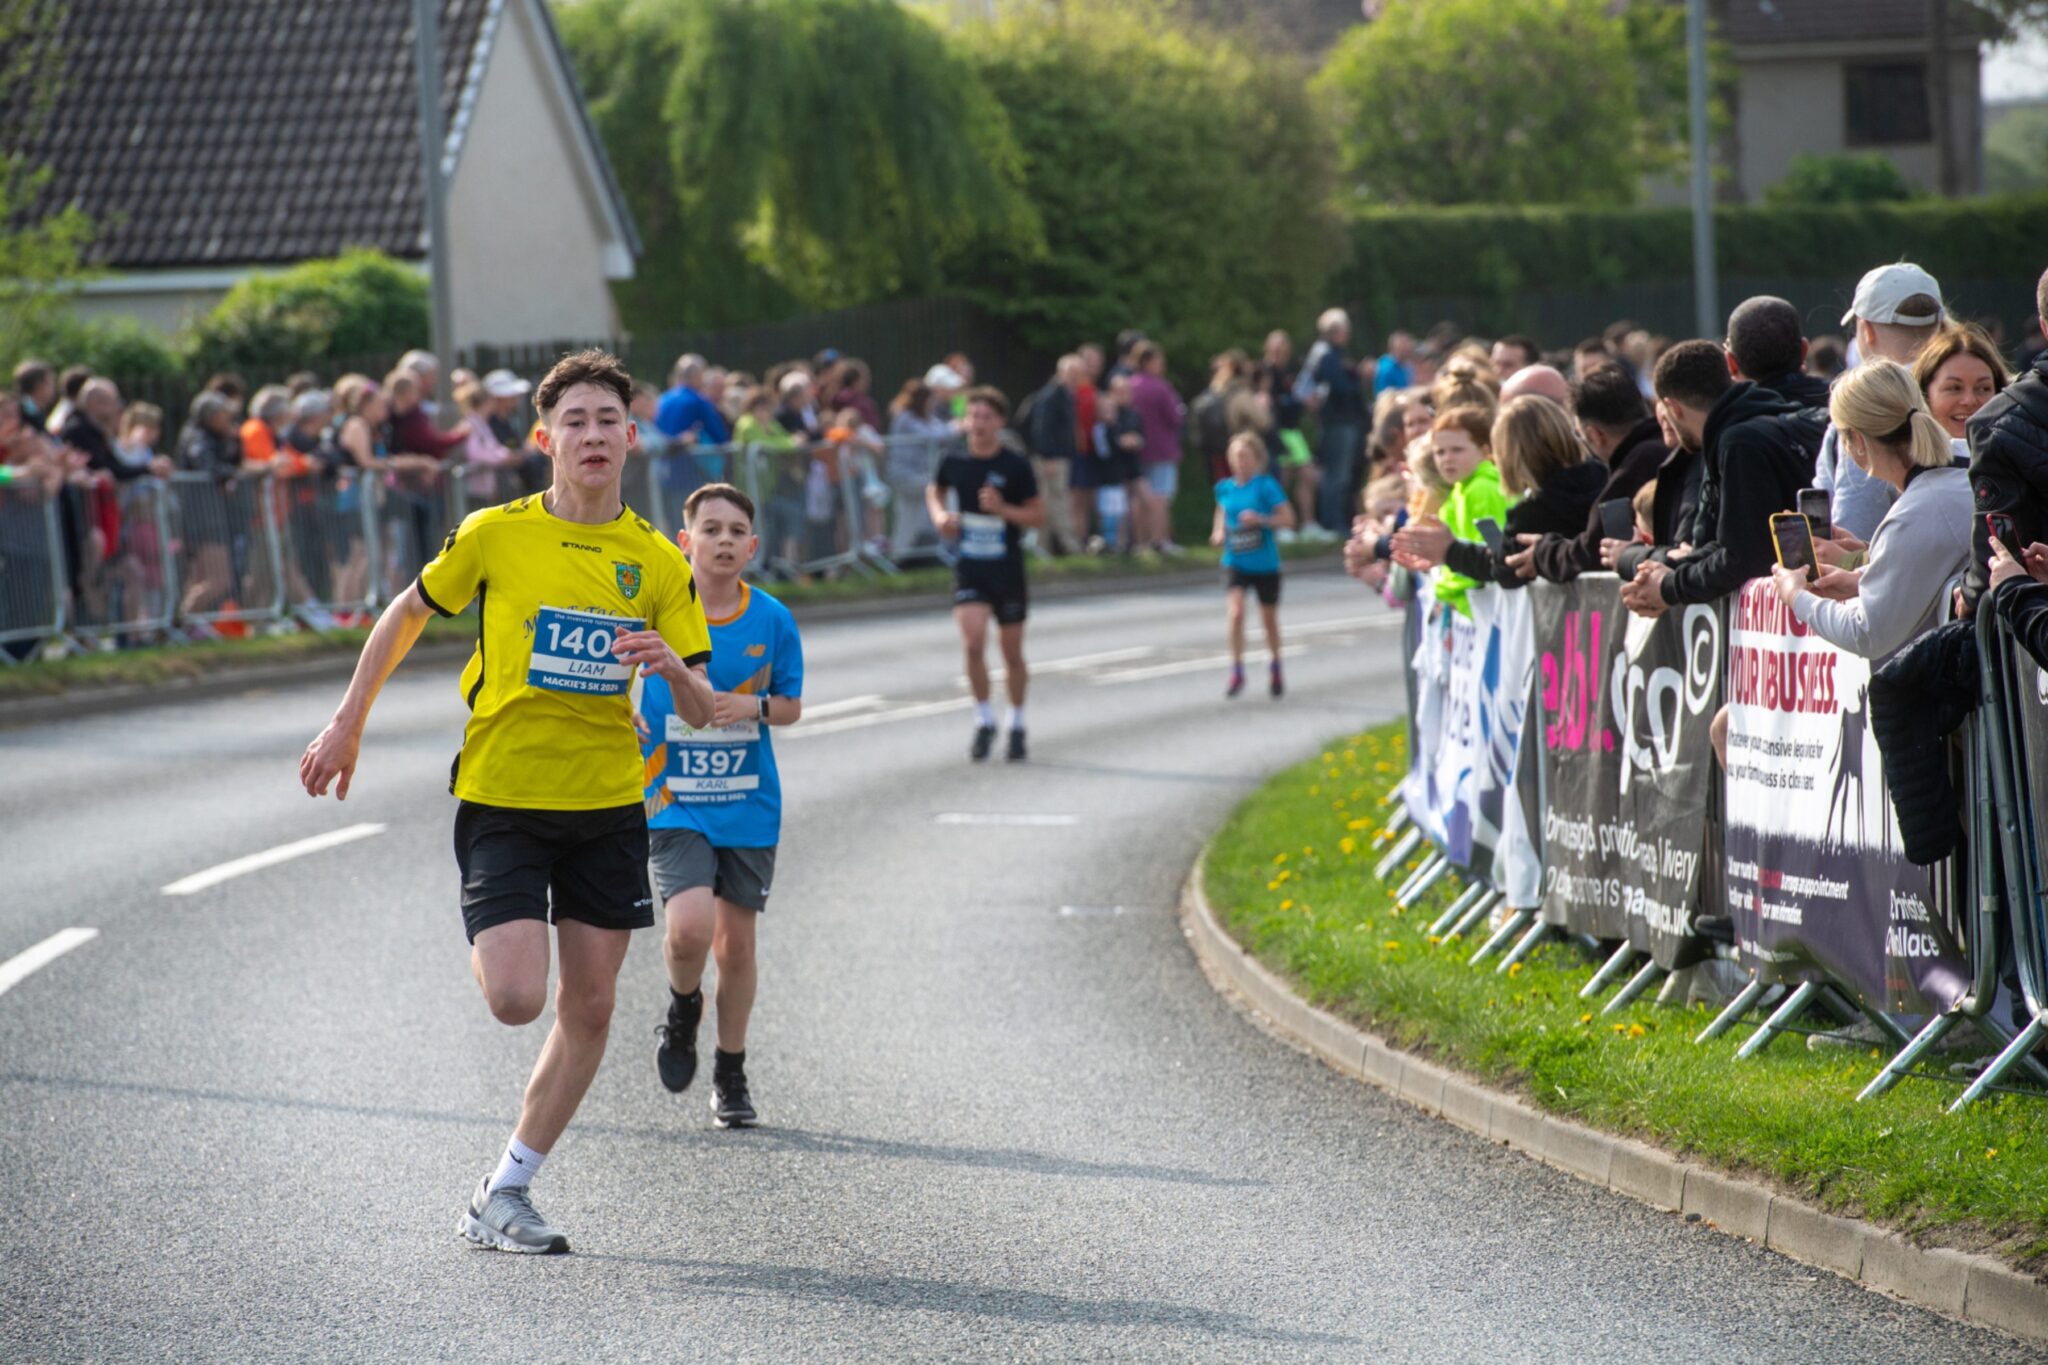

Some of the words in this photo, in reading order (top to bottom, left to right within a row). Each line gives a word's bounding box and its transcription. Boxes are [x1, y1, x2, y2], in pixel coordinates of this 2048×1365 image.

[561, 541, 602, 553] STANNO
[568, 661, 606, 676] LIAM
[543, 676, 587, 691] MACKIE'S
[600, 683, 619, 692] 2024
[678, 748, 747, 775] 1397
[696, 779, 729, 789] KARL
